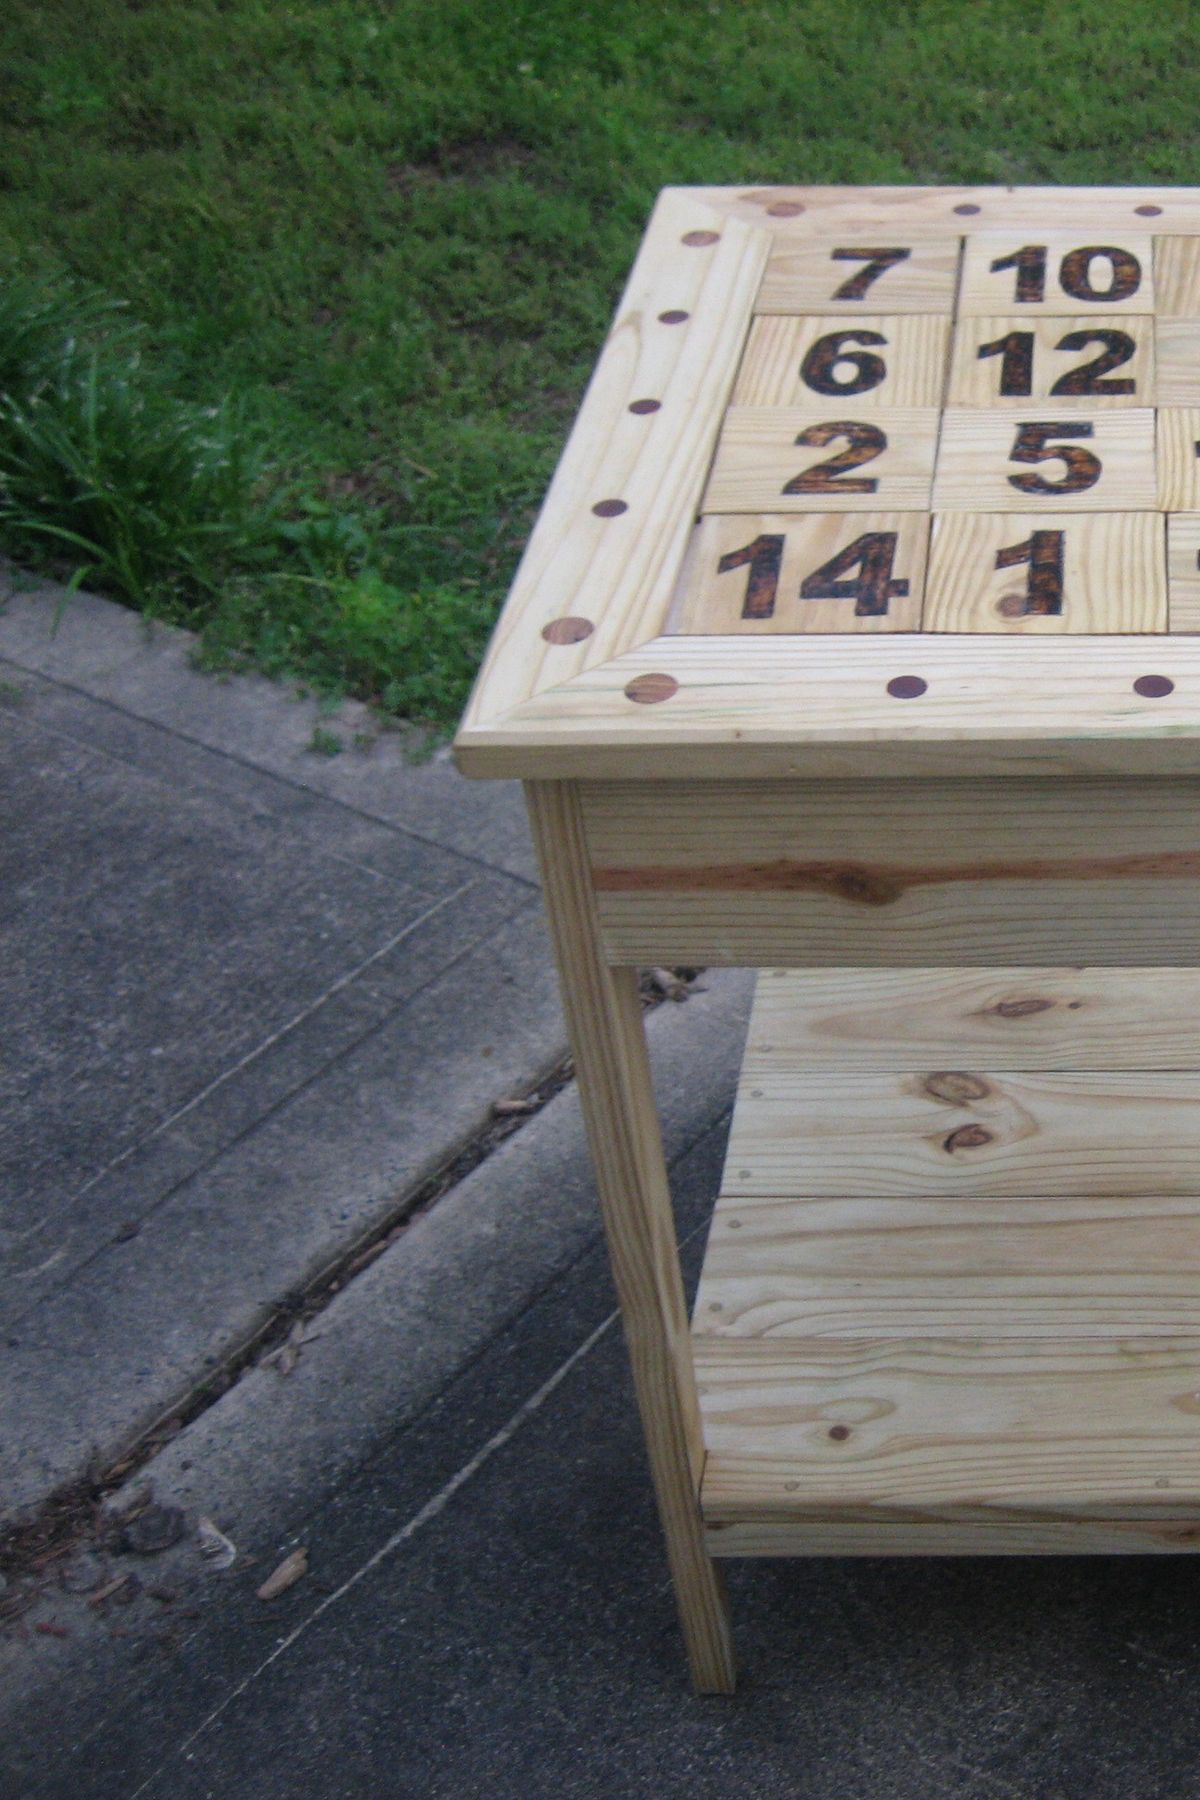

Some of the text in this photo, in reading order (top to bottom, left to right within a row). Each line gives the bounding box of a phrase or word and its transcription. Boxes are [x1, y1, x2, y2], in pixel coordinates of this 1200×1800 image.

[831, 247, 911, 301] 7
[990, 246, 1142, 303] 10
[799, 329, 888, 397] 6
[977, 328, 1136, 397] 12
[782, 420, 887, 495] 2
[1007, 421, 1102, 495] 5
[717, 531, 910, 620] 14
[994, 530, 1065, 616] 1
